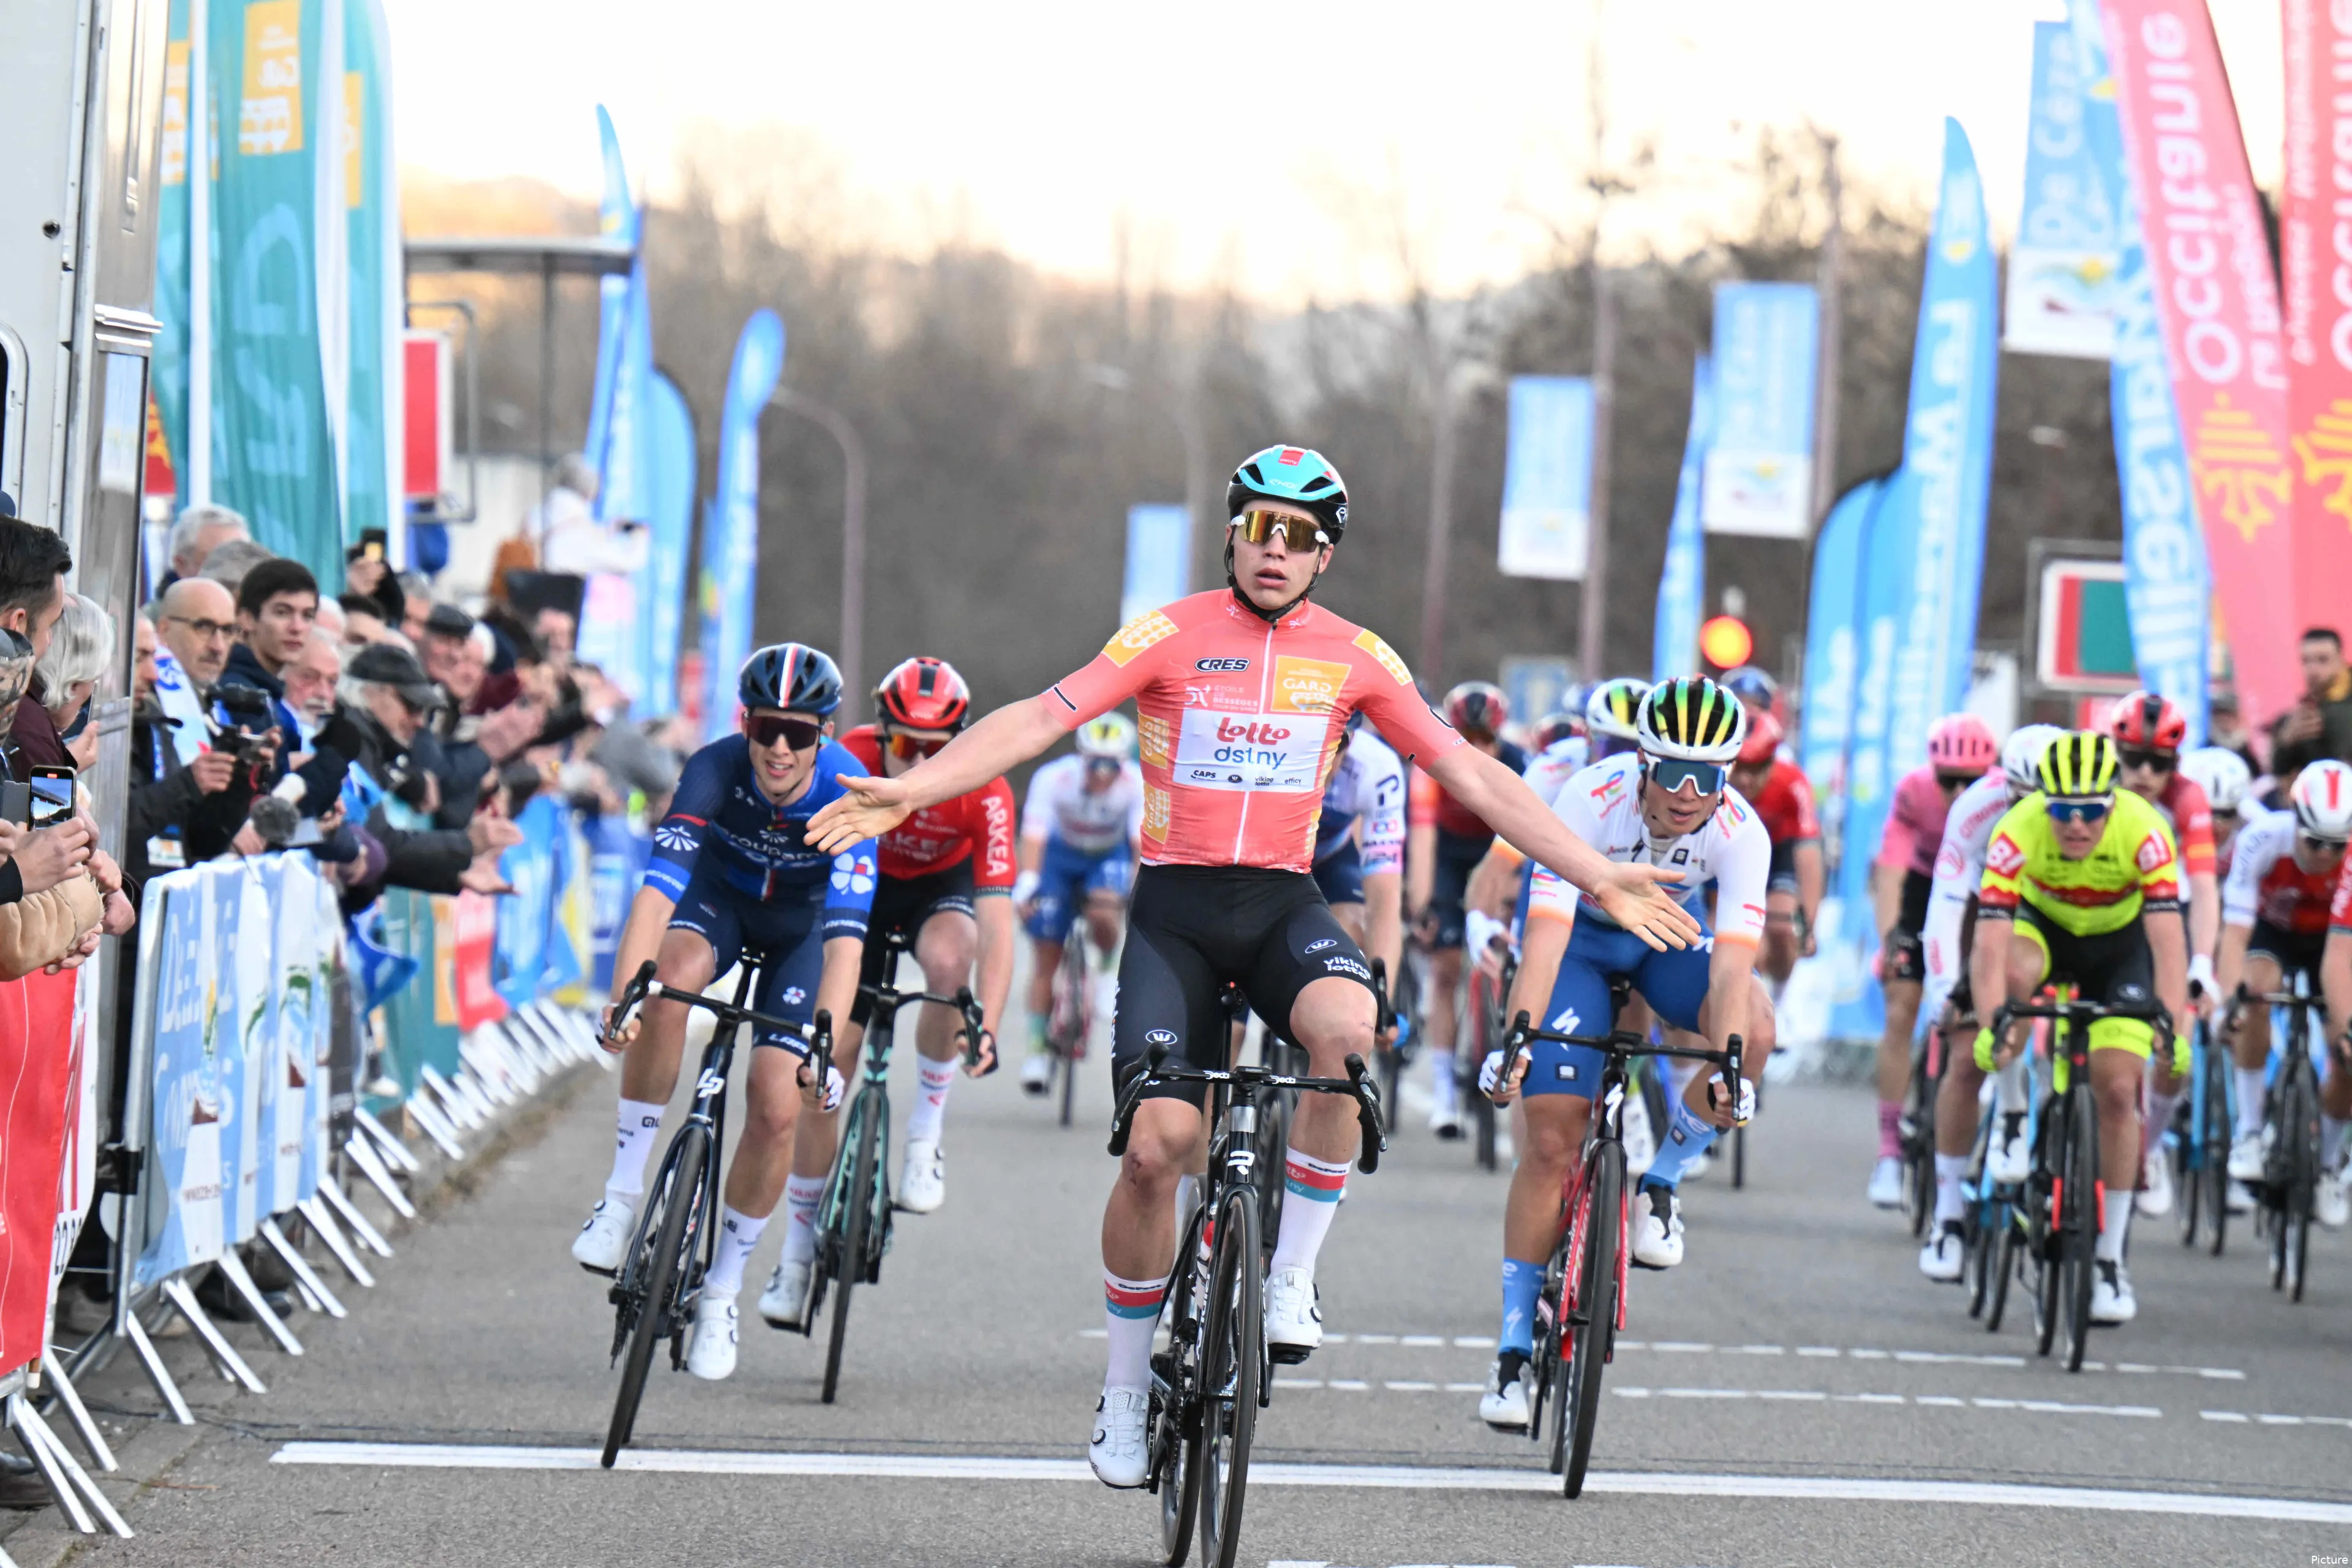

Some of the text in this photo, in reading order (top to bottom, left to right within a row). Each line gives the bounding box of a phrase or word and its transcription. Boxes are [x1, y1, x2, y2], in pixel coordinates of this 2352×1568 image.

[1195, 658, 1250, 672] CRES
[1283, 677, 1332, 693] GARD
[1216, 717, 1291, 745] lotto
[1194, 770, 1216, 778] CAPS
[1284, 778, 1302, 787] efficy
[981, 796, 1010, 878] ARKEA
[1323, 957, 1371, 980] viking
[1327, 964, 1368, 980] lotto
[1203, 1070, 1231, 1080] Deda
[1269, 1075, 1296, 1085] Deda
